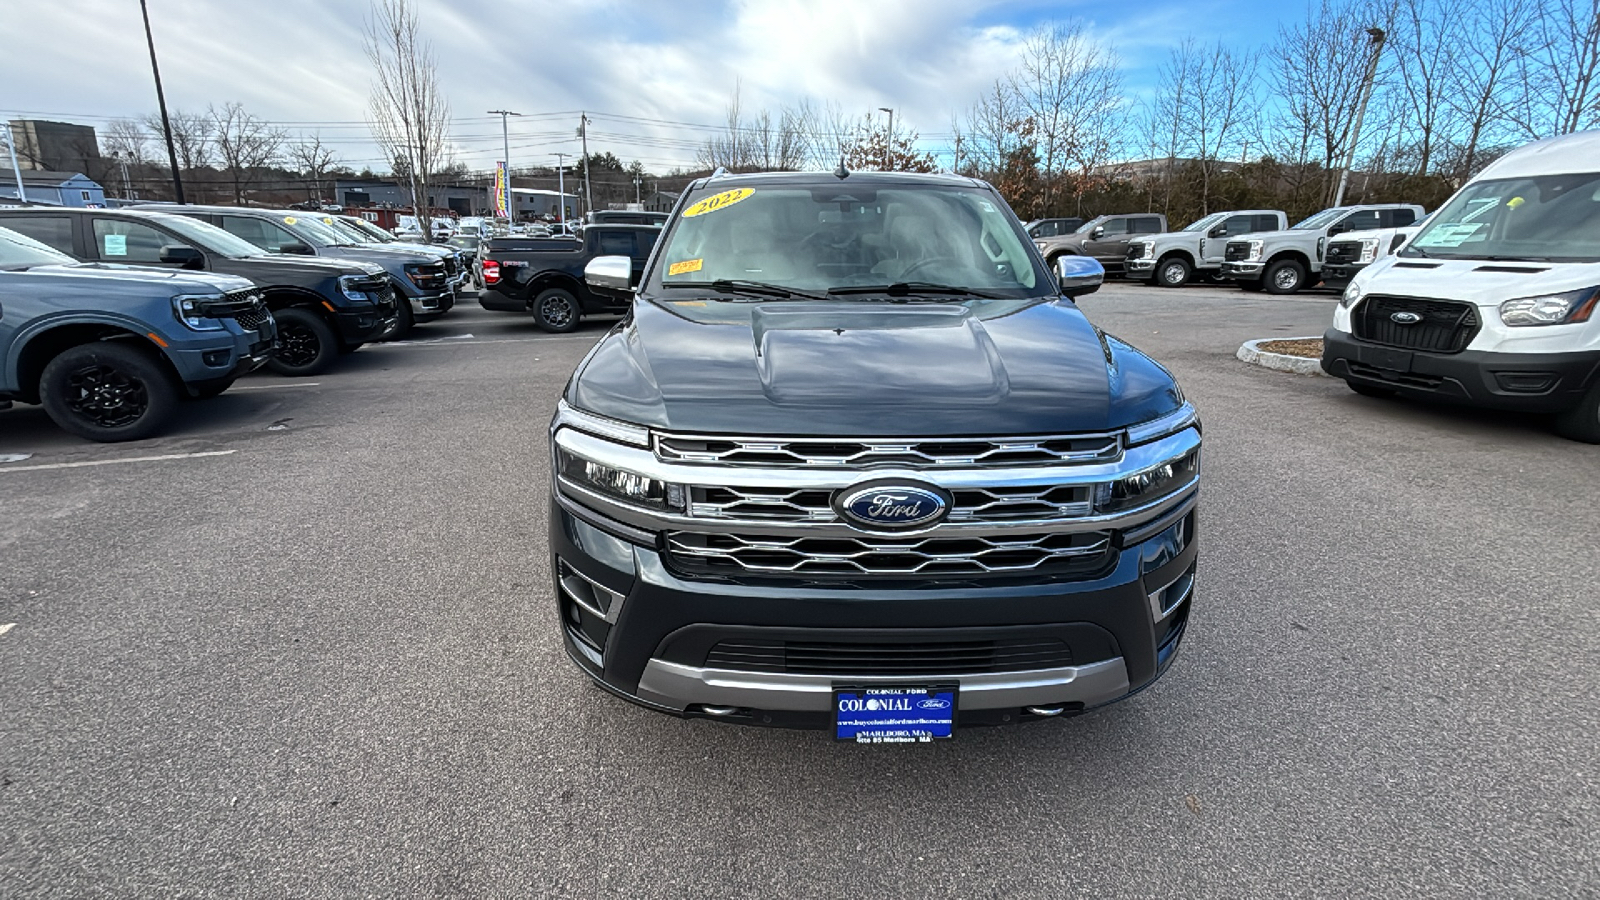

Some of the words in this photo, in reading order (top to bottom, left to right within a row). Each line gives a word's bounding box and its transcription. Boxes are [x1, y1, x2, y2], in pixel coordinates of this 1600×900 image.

[697, 190, 742, 214] 2022
[867, 494, 922, 517] Ford
[839, 699, 912, 712] COLONIAL
